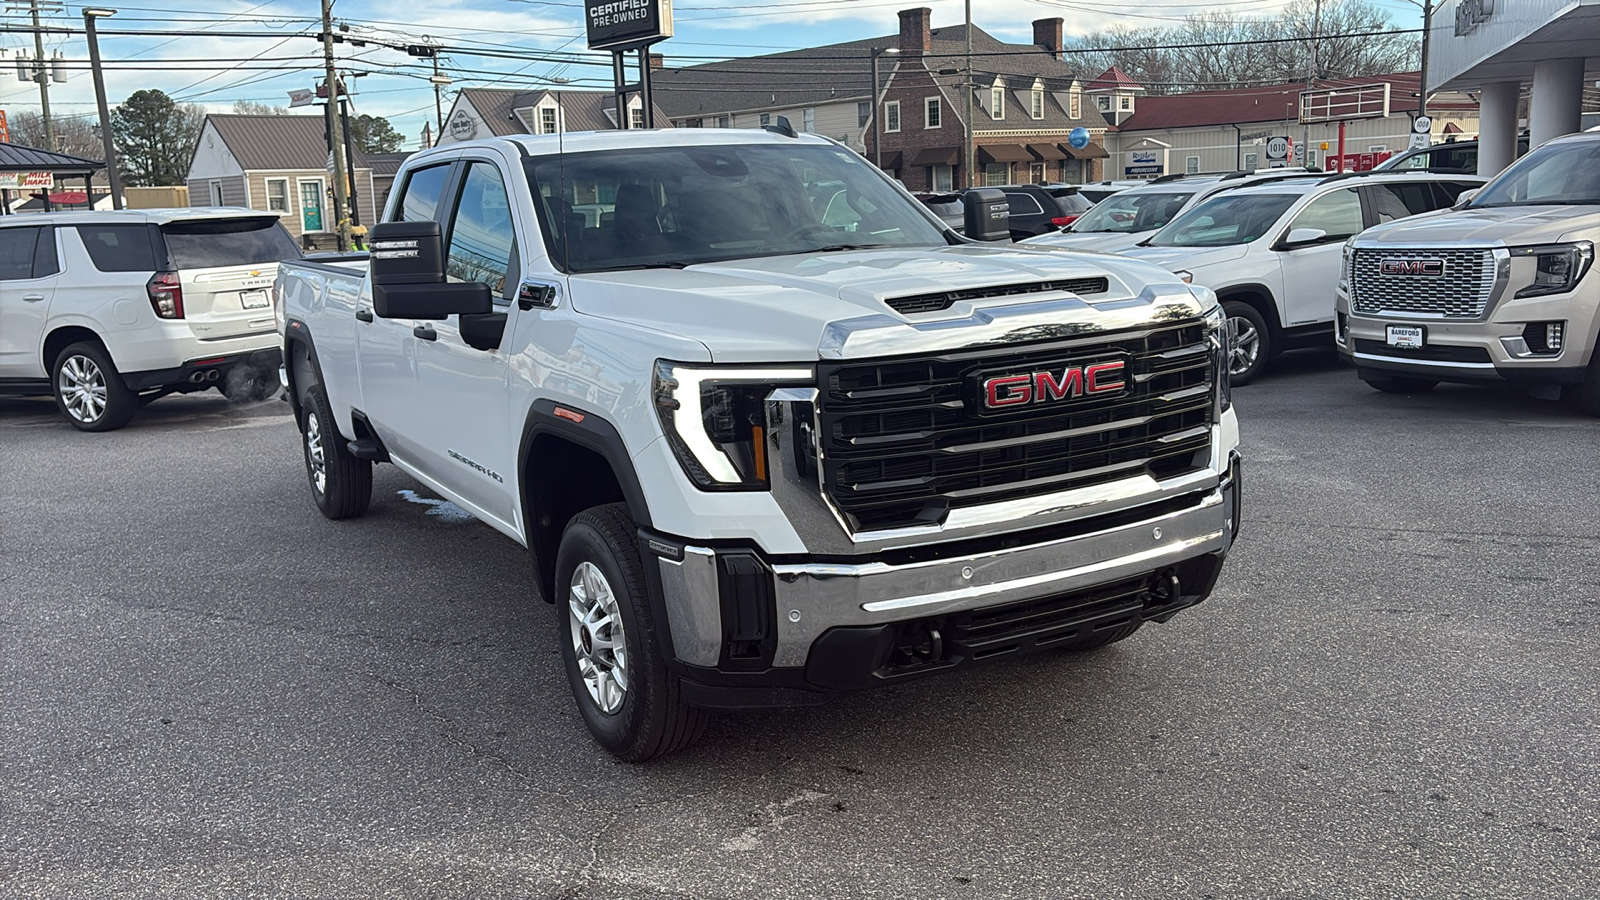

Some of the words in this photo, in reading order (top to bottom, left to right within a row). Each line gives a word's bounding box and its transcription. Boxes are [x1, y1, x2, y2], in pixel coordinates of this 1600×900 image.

[590, 0, 650, 18] CERTIFIED
[593, 8, 648, 28] PRE-OWNED
[1269, 143, 1287, 153] 1010
[1130, 166, 1159, 174] PROGRESSIVE
[1382, 261, 1441, 275] GMC
[1391, 329, 1420, 337] BAREFORD
[984, 360, 1126, 408] GMC
[447, 449, 486, 474] SIERRA
[487, 468, 504, 484] HD
